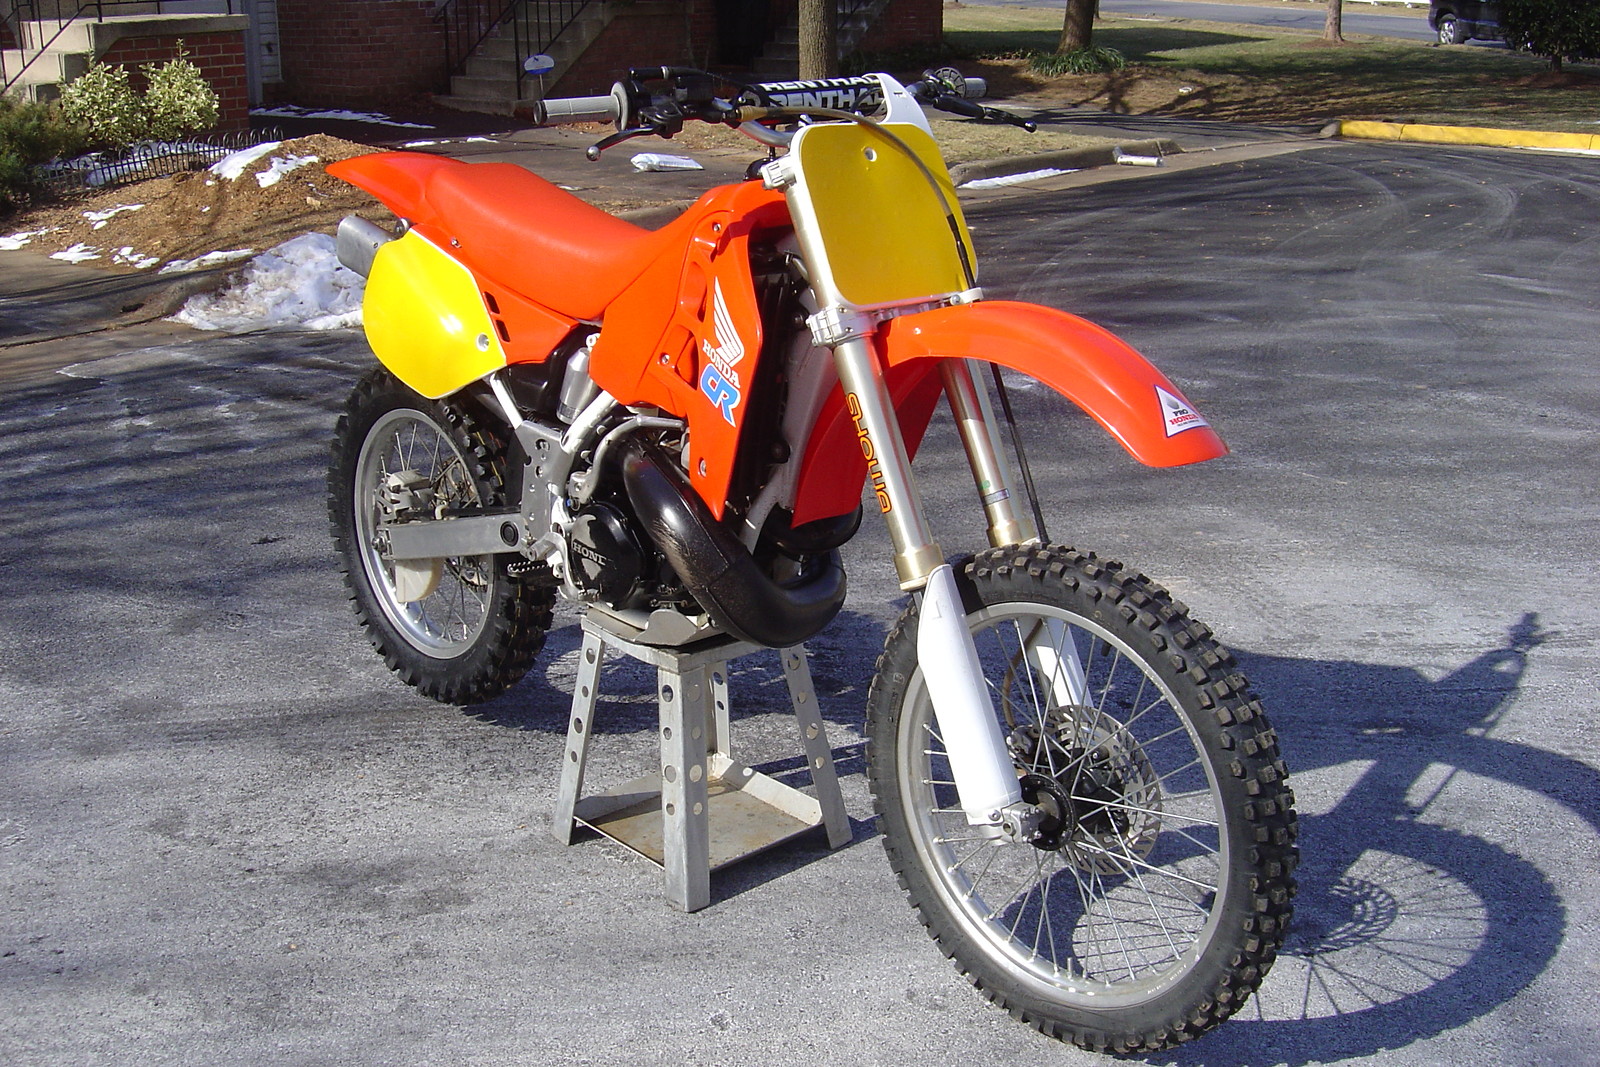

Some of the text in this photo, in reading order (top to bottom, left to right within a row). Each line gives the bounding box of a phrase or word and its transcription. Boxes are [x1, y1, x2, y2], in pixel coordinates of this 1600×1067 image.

[758, 76, 880, 92] RENTHAL
[768, 87, 884, 110] RENTHAL
[702, 338, 741, 389] HONDA
[699, 362, 741, 428] CR
[1169, 413, 1199, 425] HONDA
[845, 391, 892, 514] SHOWA
